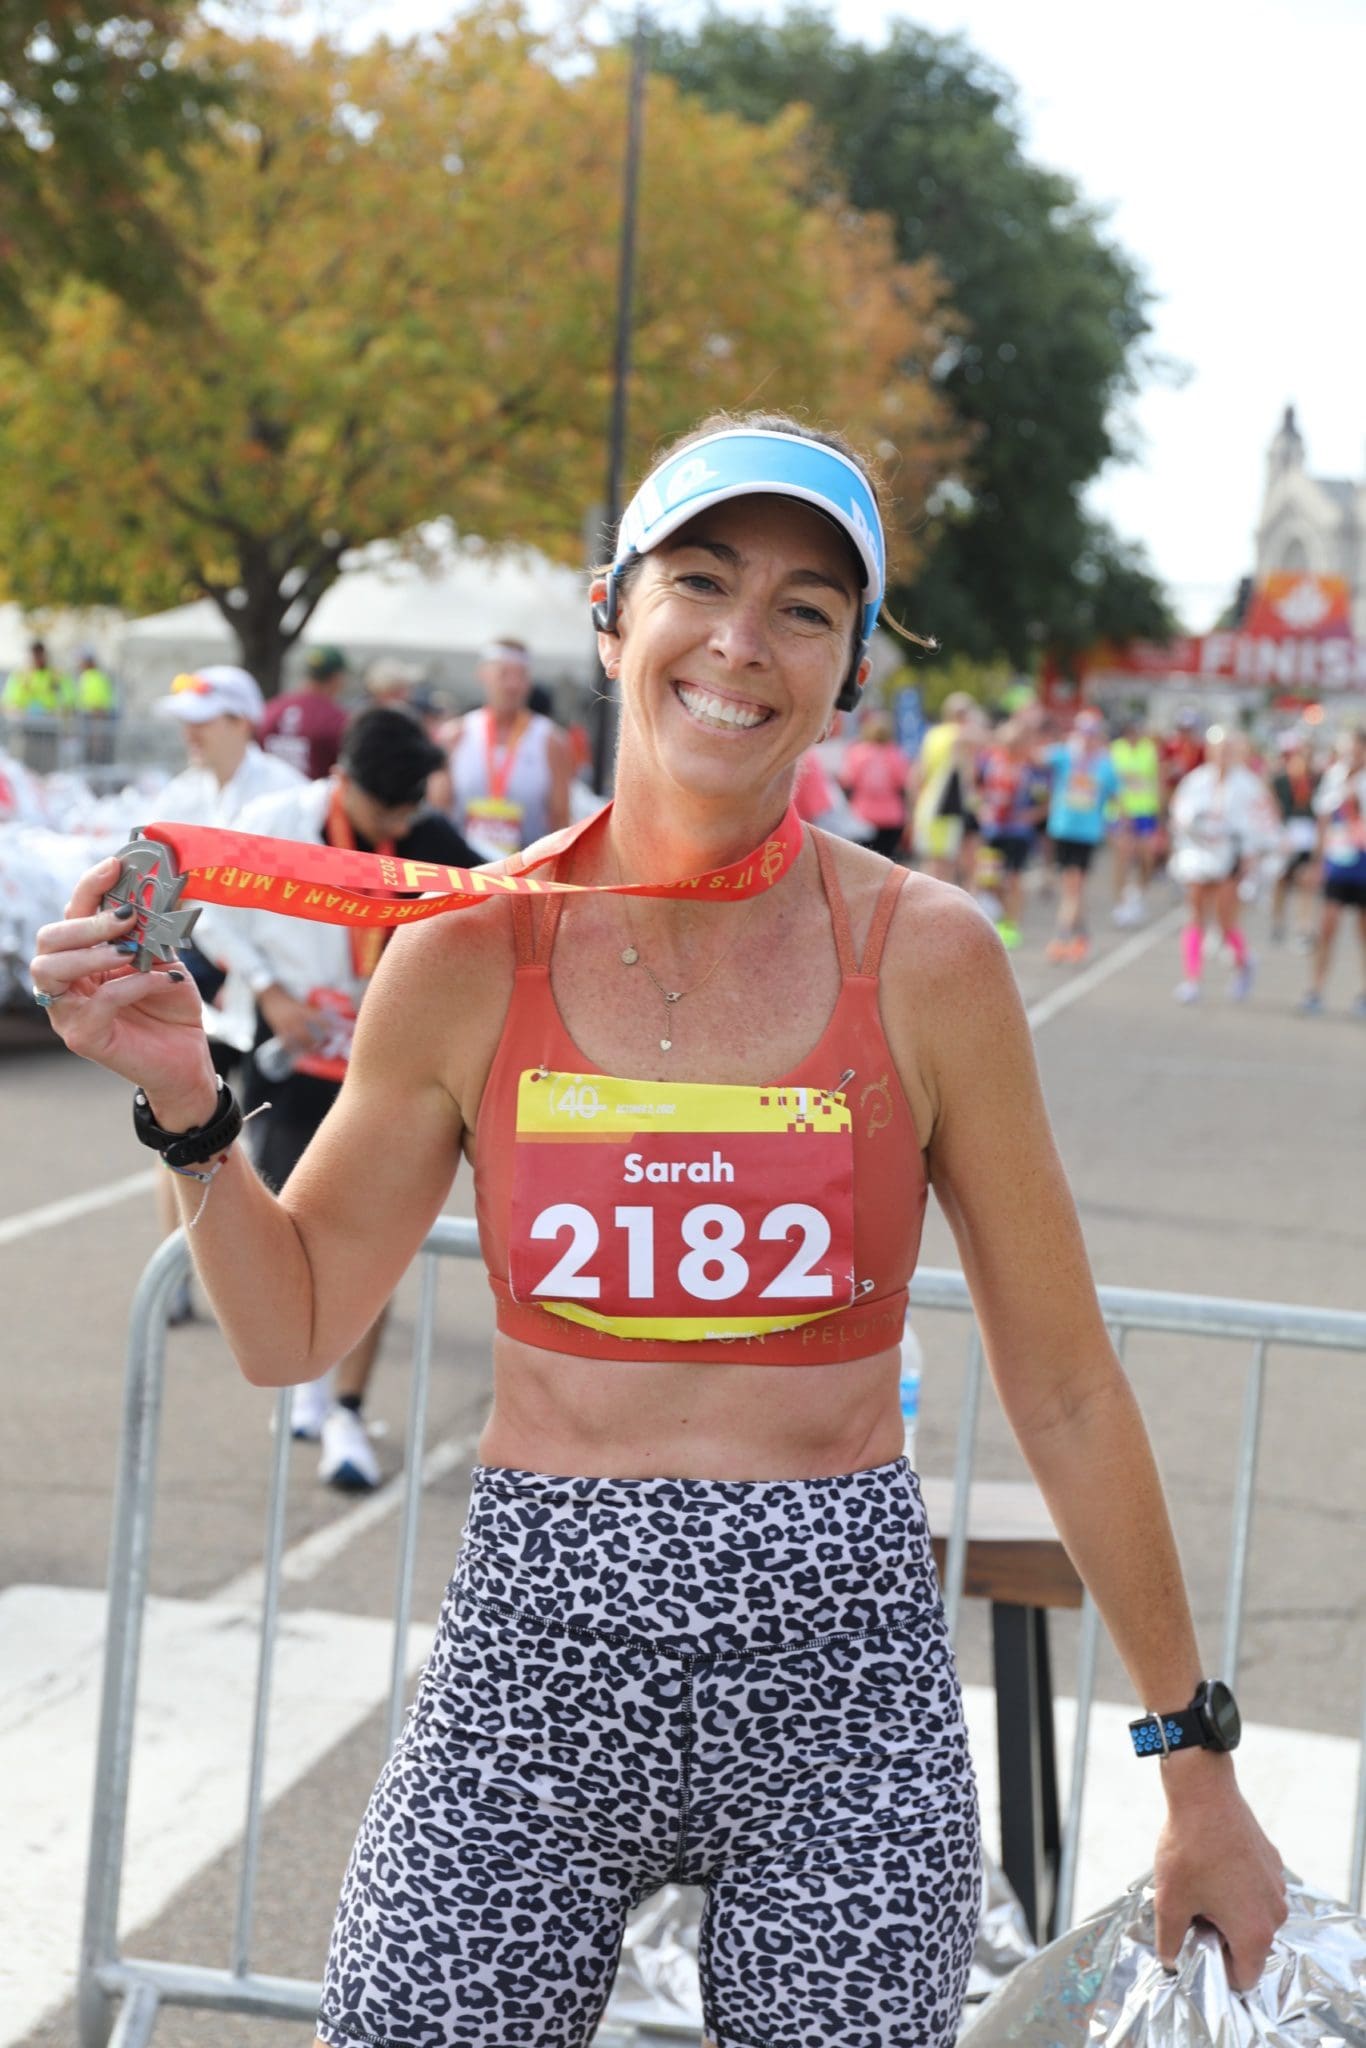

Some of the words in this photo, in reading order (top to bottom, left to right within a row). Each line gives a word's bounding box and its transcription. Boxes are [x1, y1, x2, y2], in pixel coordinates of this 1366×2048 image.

[379, 858, 398, 887] 2022
[403, 861, 592, 893] FINI
[709, 866, 754, 890] IT'S
[283, 881, 299, 898] A
[304, 888, 369, 918] THAN
[557, 1085, 607, 1119] 40
[623, 1151, 735, 1183] Sarah
[530, 1203, 833, 1301] 2182
